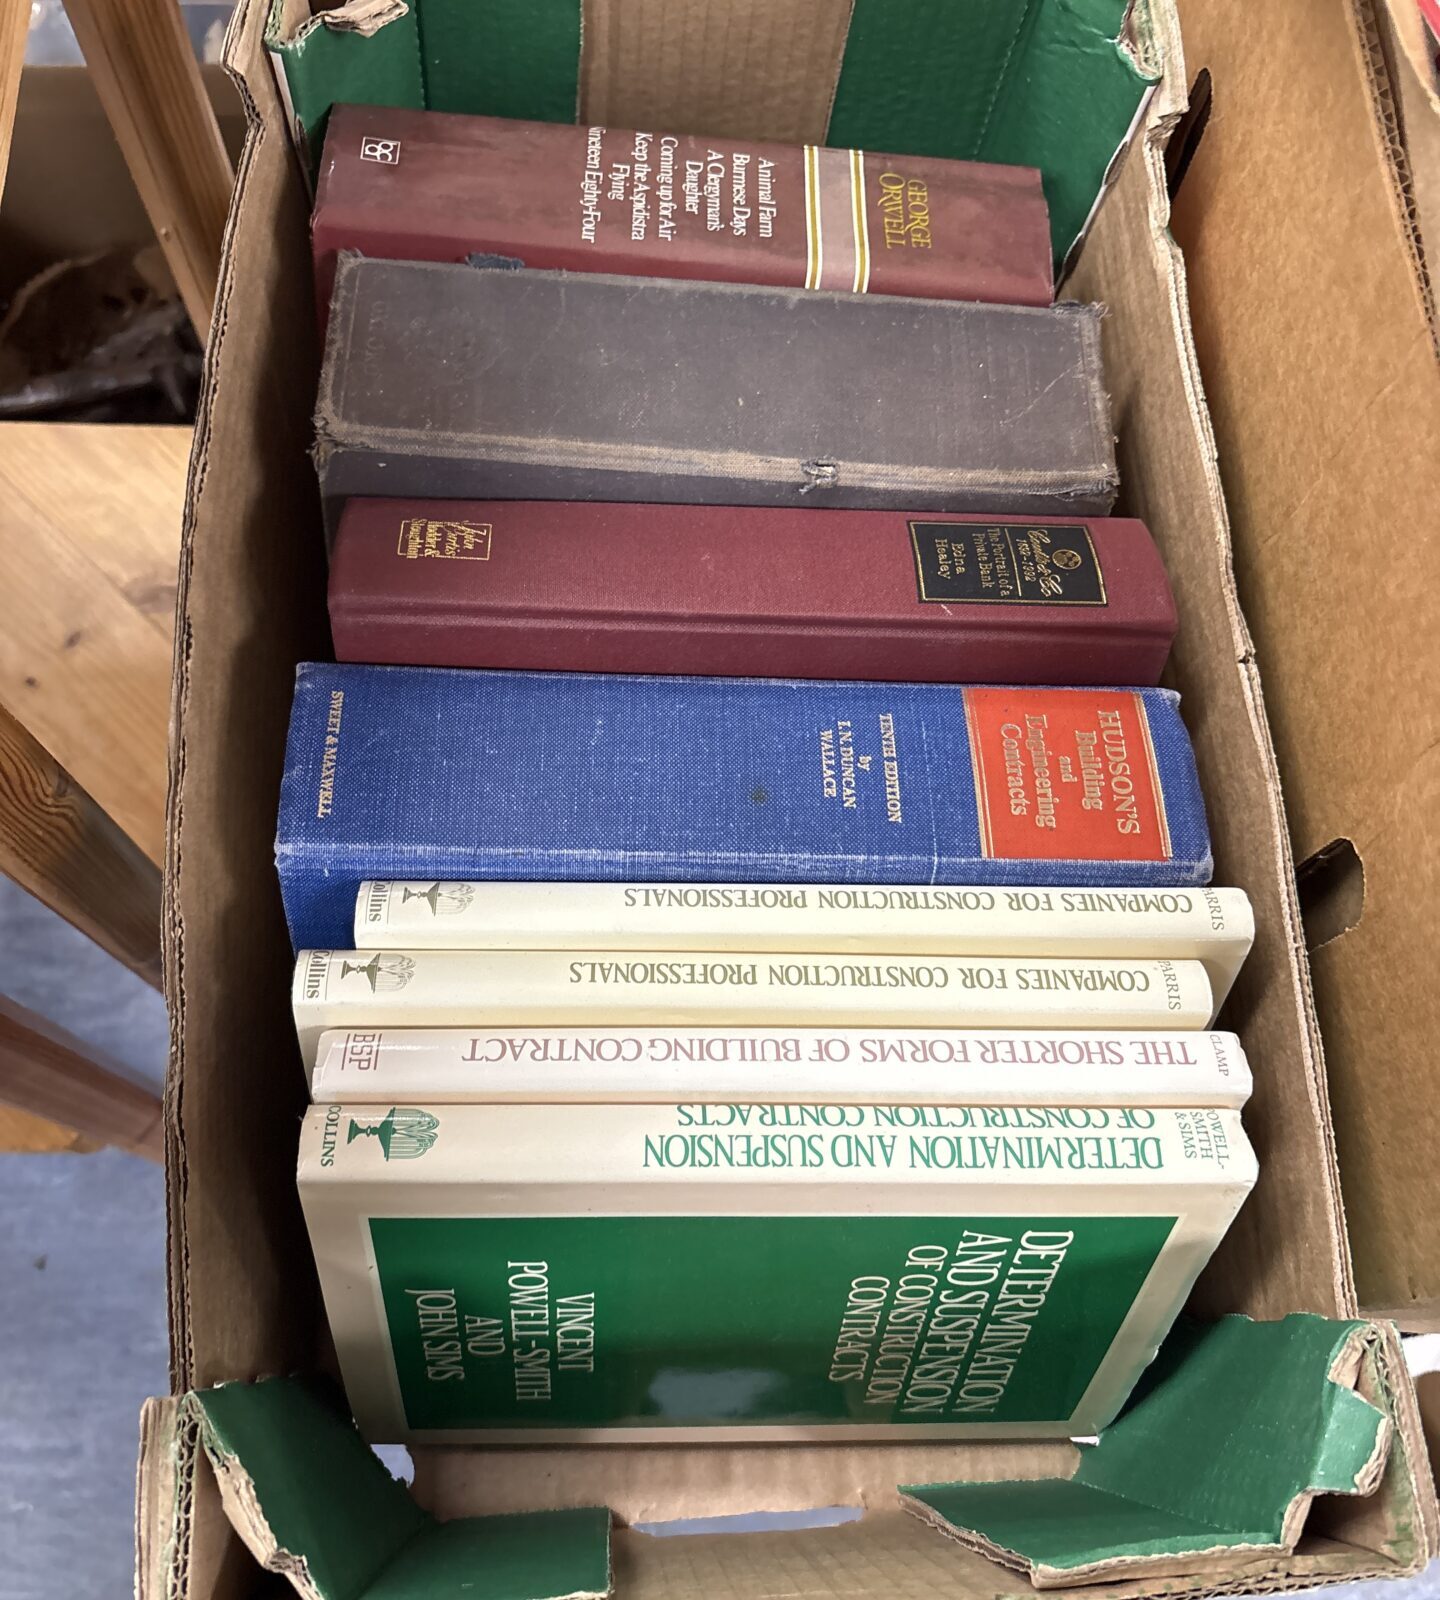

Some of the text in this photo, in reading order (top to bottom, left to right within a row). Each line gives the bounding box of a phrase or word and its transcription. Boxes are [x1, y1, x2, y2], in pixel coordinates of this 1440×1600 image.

[607, 163, 631, 201] Flying
[707, 149, 724, 161] A
[580, 171, 603, 243] Eighty-Four
[629, 132, 653, 241] Keep the Aspidistra
[655, 137, 679, 241] Coming up for Air
[682, 160, 704, 215] Daughter
[729, 153, 751, 237] Burmese Days
[758, 157, 777, 238] Animal Farm
[877, 172, 907, 249] ORWELL
[907, 179, 932, 249] GEORGE
[406, 518, 427, 558] Stoughton
[425, 548, 440, 558] &
[935, 538, 952, 580] Healey
[951, 543, 966, 575] Edna
[972, 533, 995, 589] Private Bank
[987, 528, 1013, 597] The Portrait of a
[317, 691, 344, 818] SWEET & MAXWELL
[820, 729, 837, 798] WALLACE
[857, 755, 872, 771] by
[879, 713, 903, 823] TENTH EDITION
[1000, 723, 1031, 816] Contracts
[1025, 713, 1060, 829] Engineering
[1058, 755, 1078, 783] and
[1075, 730, 1106, 811] Building
[1097, 710, 1141, 834] HUDSON'S
[624, 888, 1193, 913] COMPANIES FOR CONSTRUCTION PROFESSIONALS
[1201, 887, 1225, 931] ARRIS
[306, 950, 330, 1000] Collins
[569, 962, 1150, 992] COMPANIES FOR CONSTRUCTION PROFESSIONALS
[1157, 960, 1182, 1011] PARRIS
[348, 1033, 376, 1071] BSP
[461, 1038, 1198, 1065] THE SHORTER FORMS OF BUILDING CONTRACT
[1210, 1033, 1229, 1077] CLAMP
[320, 1105, 342, 1167] COLLINS
[676, 1104, 1155, 1129] OF CONSTRUCTION CONTRACTS
[1175, 1111, 1197, 1159] & SIMS
[1190, 1111, 1213, 1160] SMITH
[643, 1134, 1164, 1169] DETERMINATION AND SUSPENSION
[404, 1288, 466, 1381] JOHN SIMS
[464, 1314, 506, 1356] AND
[507, 1260, 552, 1401] POWELL-SMITH
[556, 1292, 595, 1373] VINCENT
[828, 1275, 890, 1382] CONTRACTS
[864, 1244, 948, 1404] OF CONSTRUCTION
[900, 1230, 1013, 1414] AND SUSPENSION
[951, 1230, 1074, 1413] DETERMINATION
